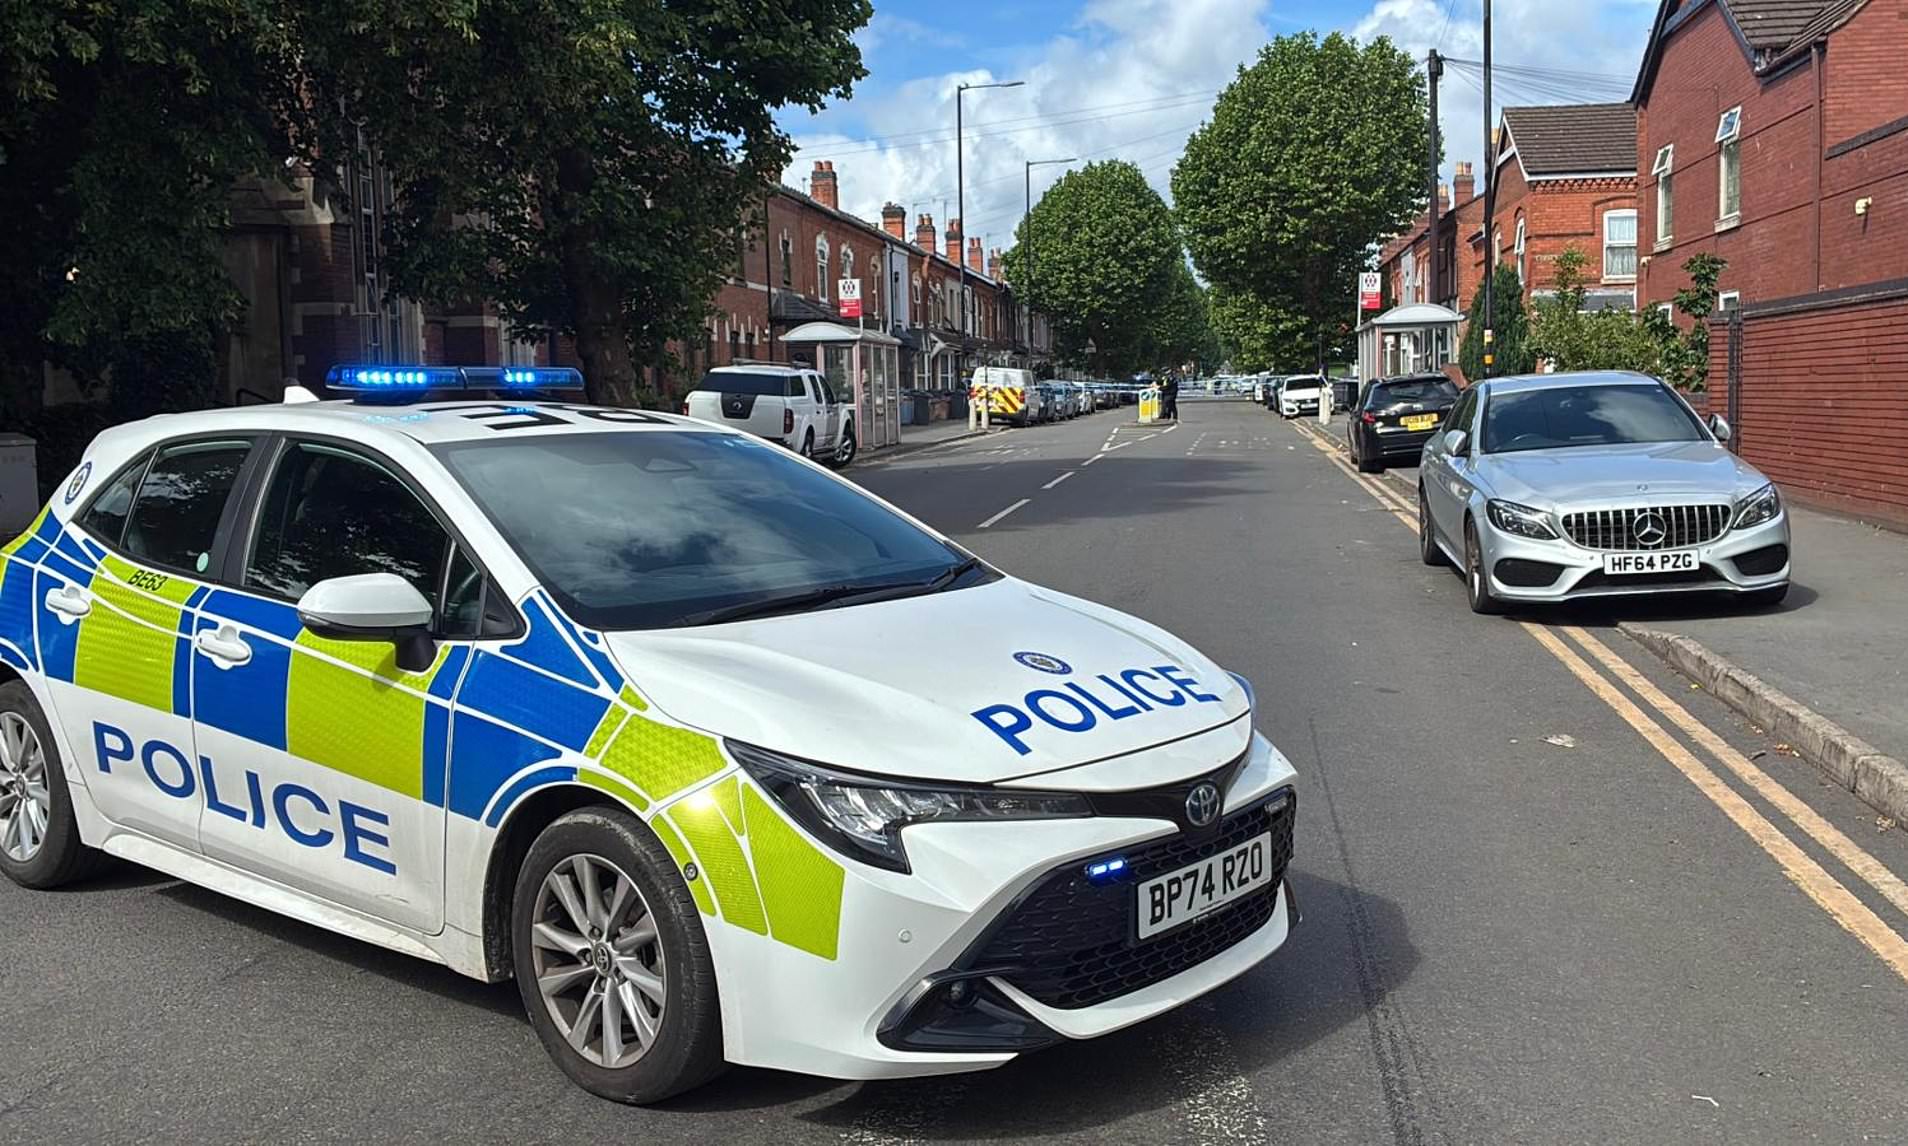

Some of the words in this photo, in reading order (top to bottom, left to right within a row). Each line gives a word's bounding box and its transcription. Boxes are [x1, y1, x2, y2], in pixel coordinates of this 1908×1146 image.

[128, 569, 169, 592] BE63
[1611, 555, 1656, 572] HF64
[1660, 553, 1692, 570] PZG
[969, 665, 1223, 756] POLICE
[93, 720, 397, 876] POLICE
[1149, 862, 1215, 926] BP74
[1222, 841, 1263, 895] RZO
